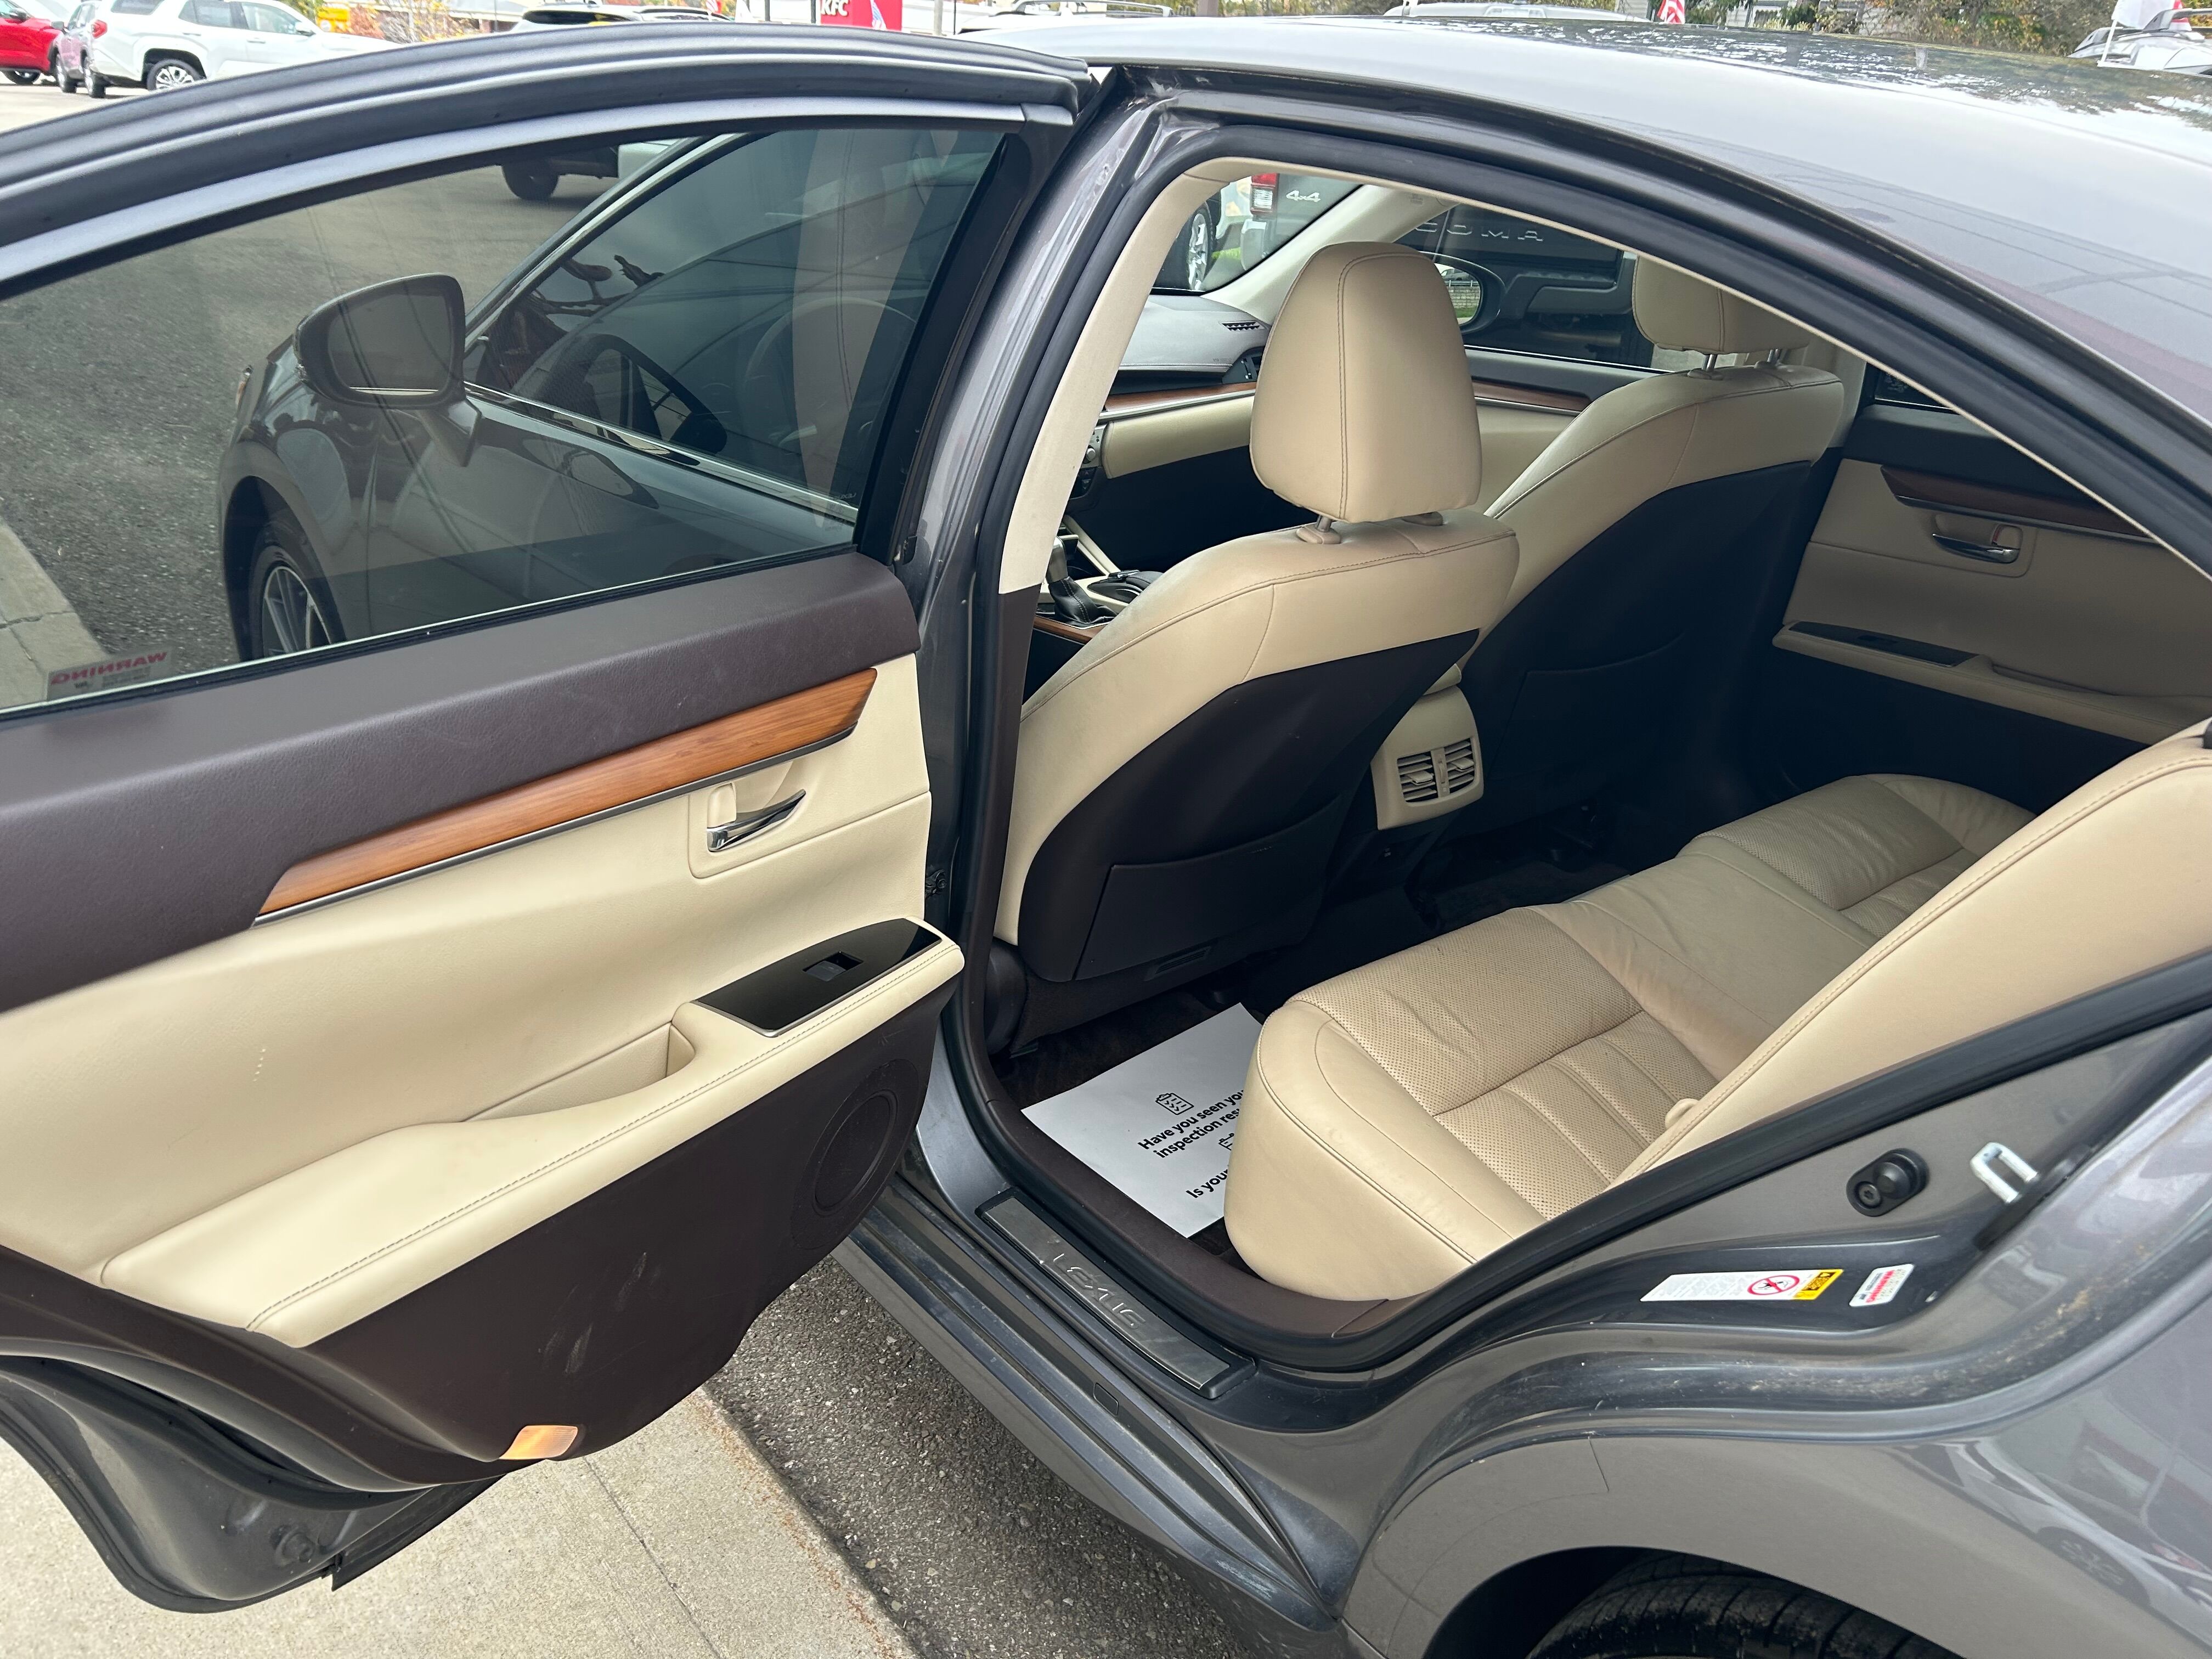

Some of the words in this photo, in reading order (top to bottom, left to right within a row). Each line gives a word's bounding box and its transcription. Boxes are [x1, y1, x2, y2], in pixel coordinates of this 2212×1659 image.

[821, 0, 849, 16] KFC
[1286, 190, 1321, 202] 4x4
[1137, 1129, 1175, 1150] Have
[1171, 1116, 1199, 1134] you
[1197, 1101, 1227, 1119] seen
[1153, 1120, 1223, 1159] inspection
[1185, 1188, 1204, 1199] Is
[1053, 1252, 1147, 1329] LEXUS
